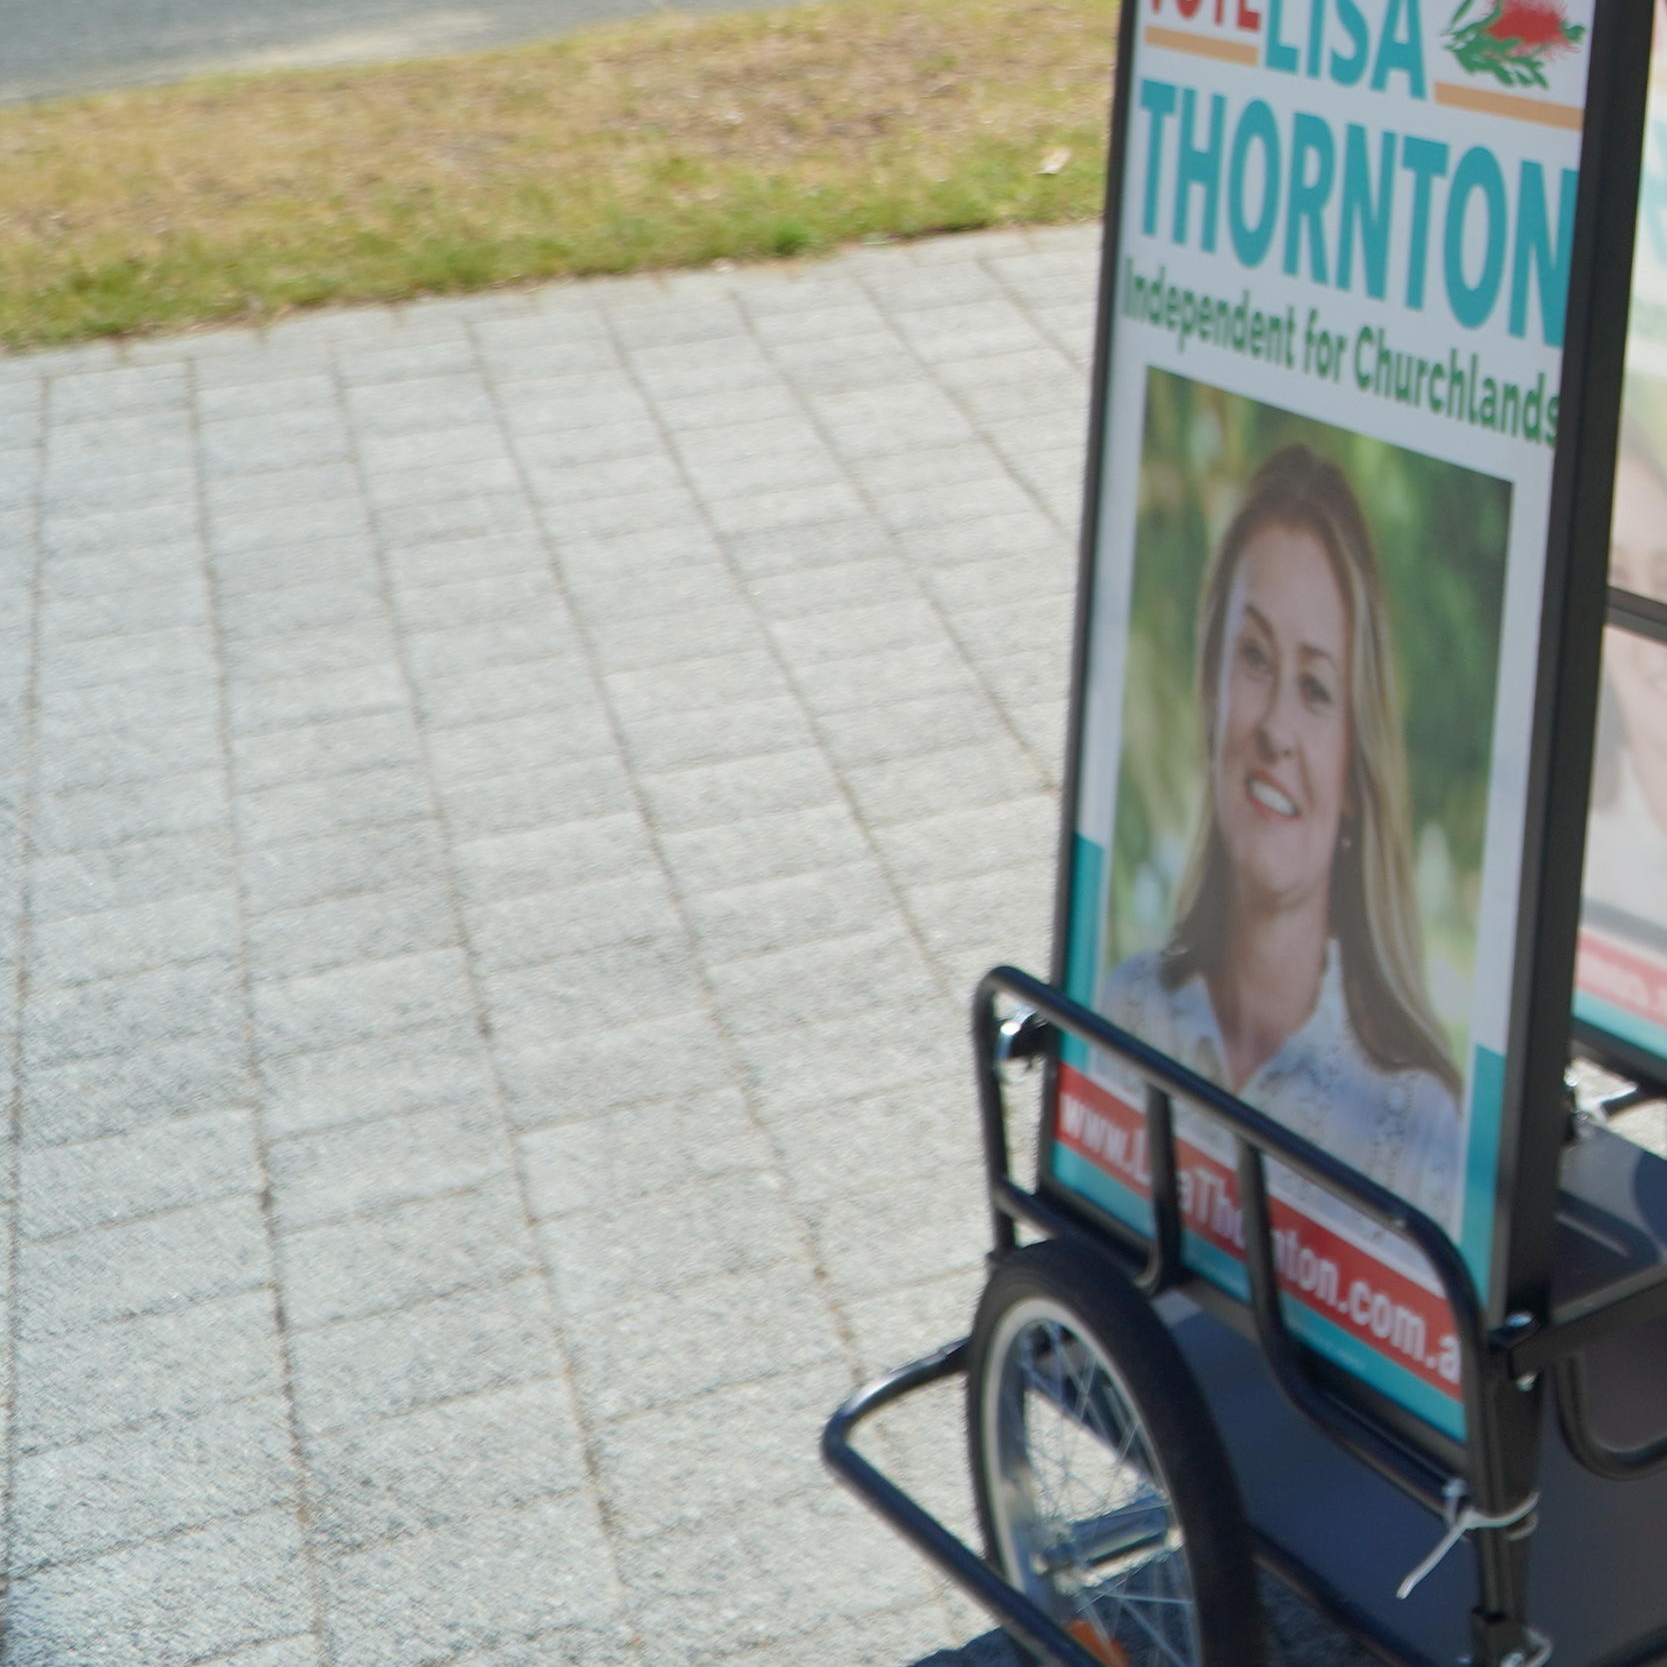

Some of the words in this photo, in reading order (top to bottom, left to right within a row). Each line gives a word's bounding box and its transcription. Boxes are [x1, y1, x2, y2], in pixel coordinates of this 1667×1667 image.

[1140, 79, 1579, 349] THORNTON
[1125, 257, 1296, 370] Independent
[1304, 308, 1347, 384] for
